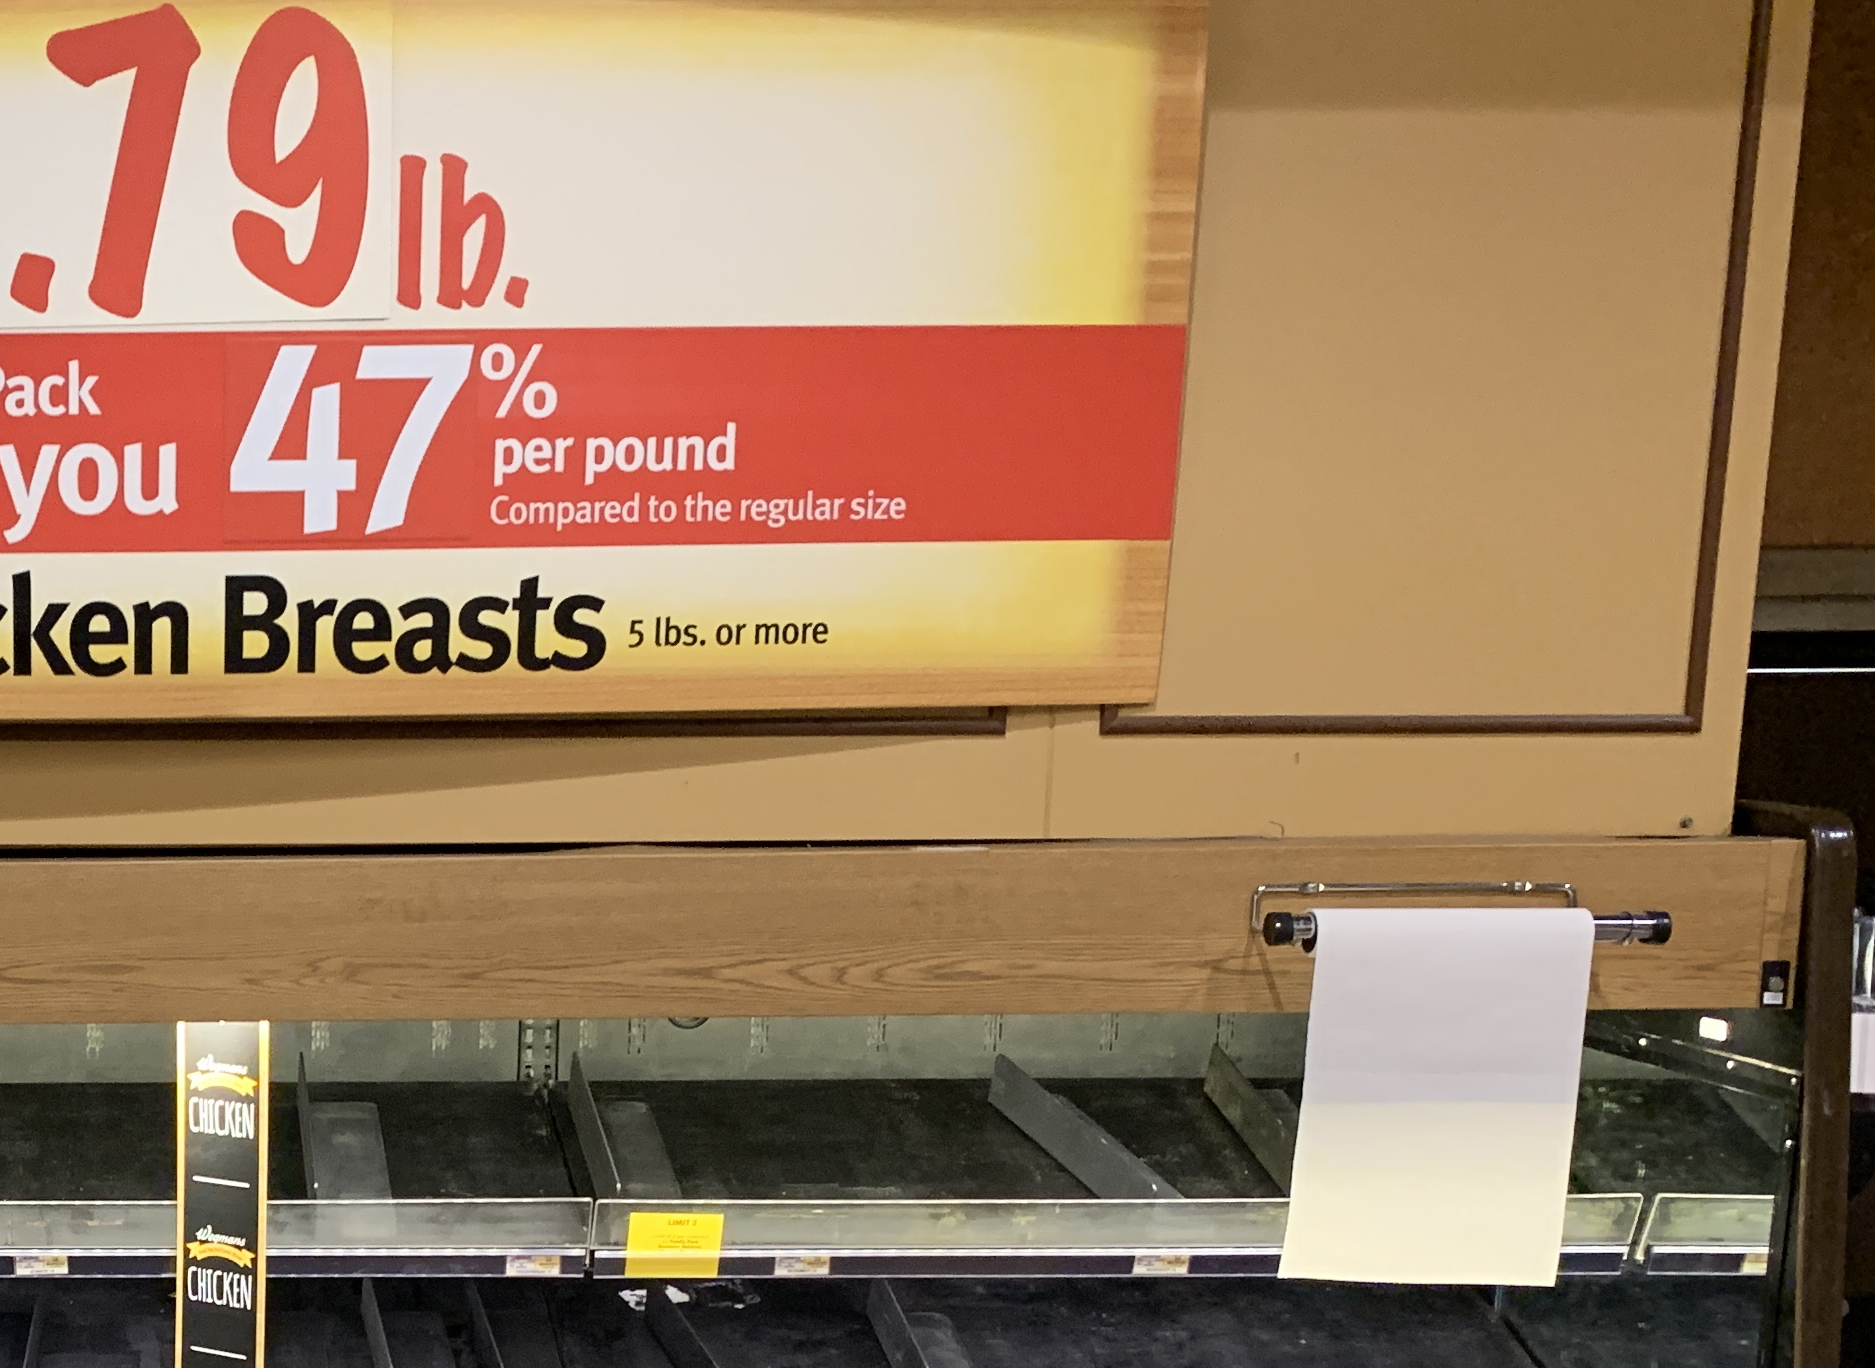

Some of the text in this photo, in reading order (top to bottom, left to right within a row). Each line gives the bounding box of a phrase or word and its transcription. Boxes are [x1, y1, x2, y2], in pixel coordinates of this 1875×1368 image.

[396, 152, 529, 311] lb.
[493, 421, 737, 487] per pound
[488, 490, 907, 532] Compared to the regular size
[223, 574, 607, 675] Breasts
[627, 620, 645, 649] 5
[654, 616, 707, 649] lbs.
[714, 622, 747, 647] or
[752, 619, 829, 646] more
[188, 1096, 255, 1140] CHICKEN
[195, 1224, 246, 1247] Wegmans
[187, 1265, 253, 1311] CHICKEN
